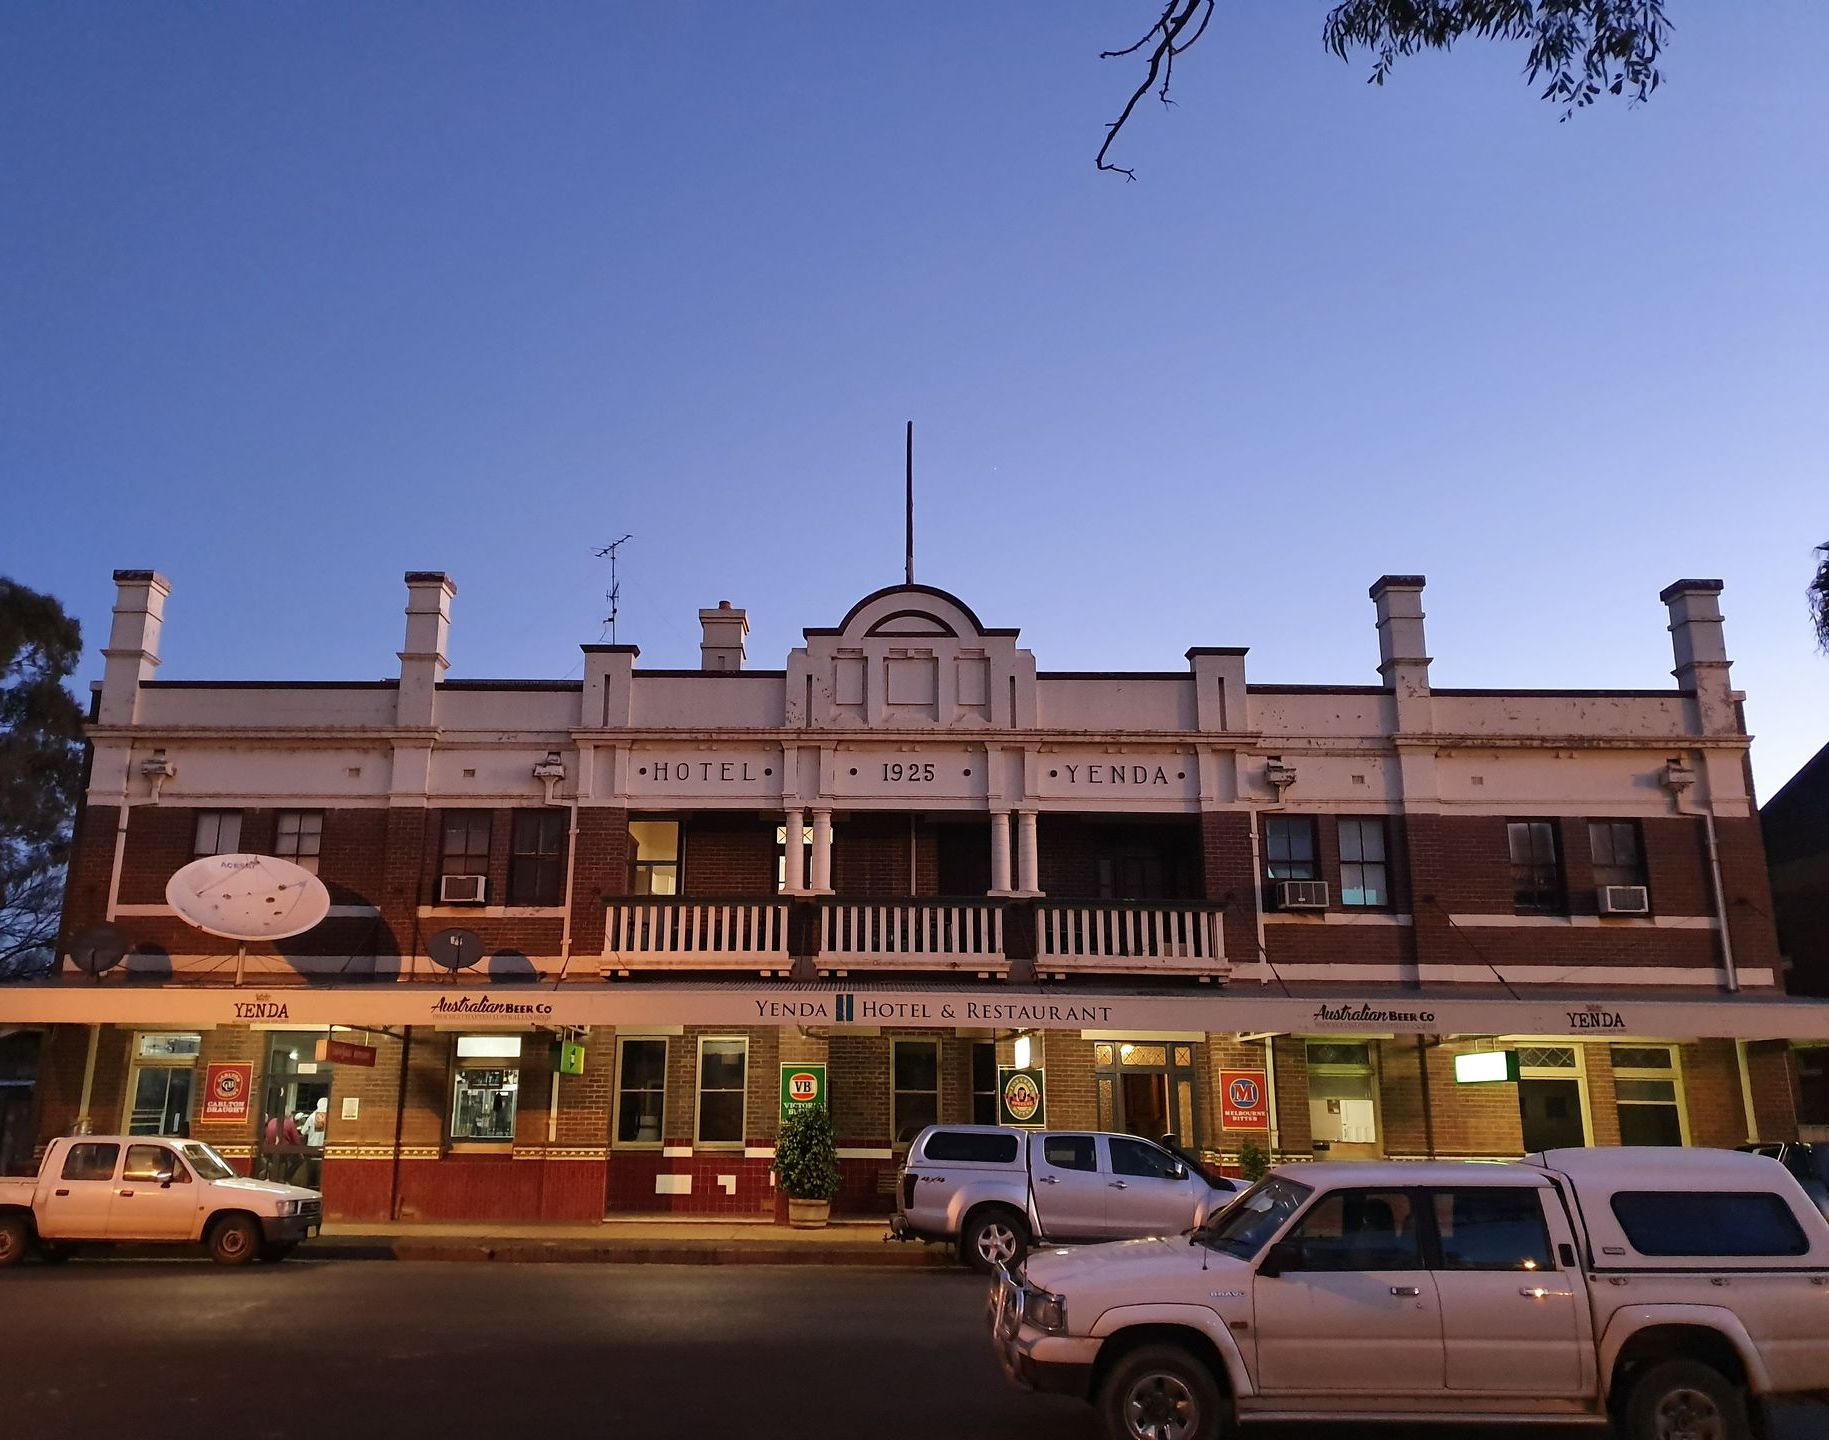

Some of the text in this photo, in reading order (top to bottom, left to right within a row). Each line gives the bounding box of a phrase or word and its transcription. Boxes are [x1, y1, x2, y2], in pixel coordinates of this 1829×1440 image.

[653, 762, 757, 781] HOTEL
[883, 763, 935, 782] 1925
[1065, 764, 1168, 784] YENDA
[233, 1002, 289, 1018] YENDA
[431, 995, 505, 1013] Australian
[505, 1003, 534, 1014] BEER
[755, 1000, 1112, 1022] YENDA HOTEL & RESTAURANT
[1313, 1002, 1389, 1022] Australian
[1388, 1011, 1418, 1022] BEER
[1566, 1012, 1627, 1028] YENDA
[794, 1080, 812, 1093] VB
[1232, 1083, 1256, 1102] M
